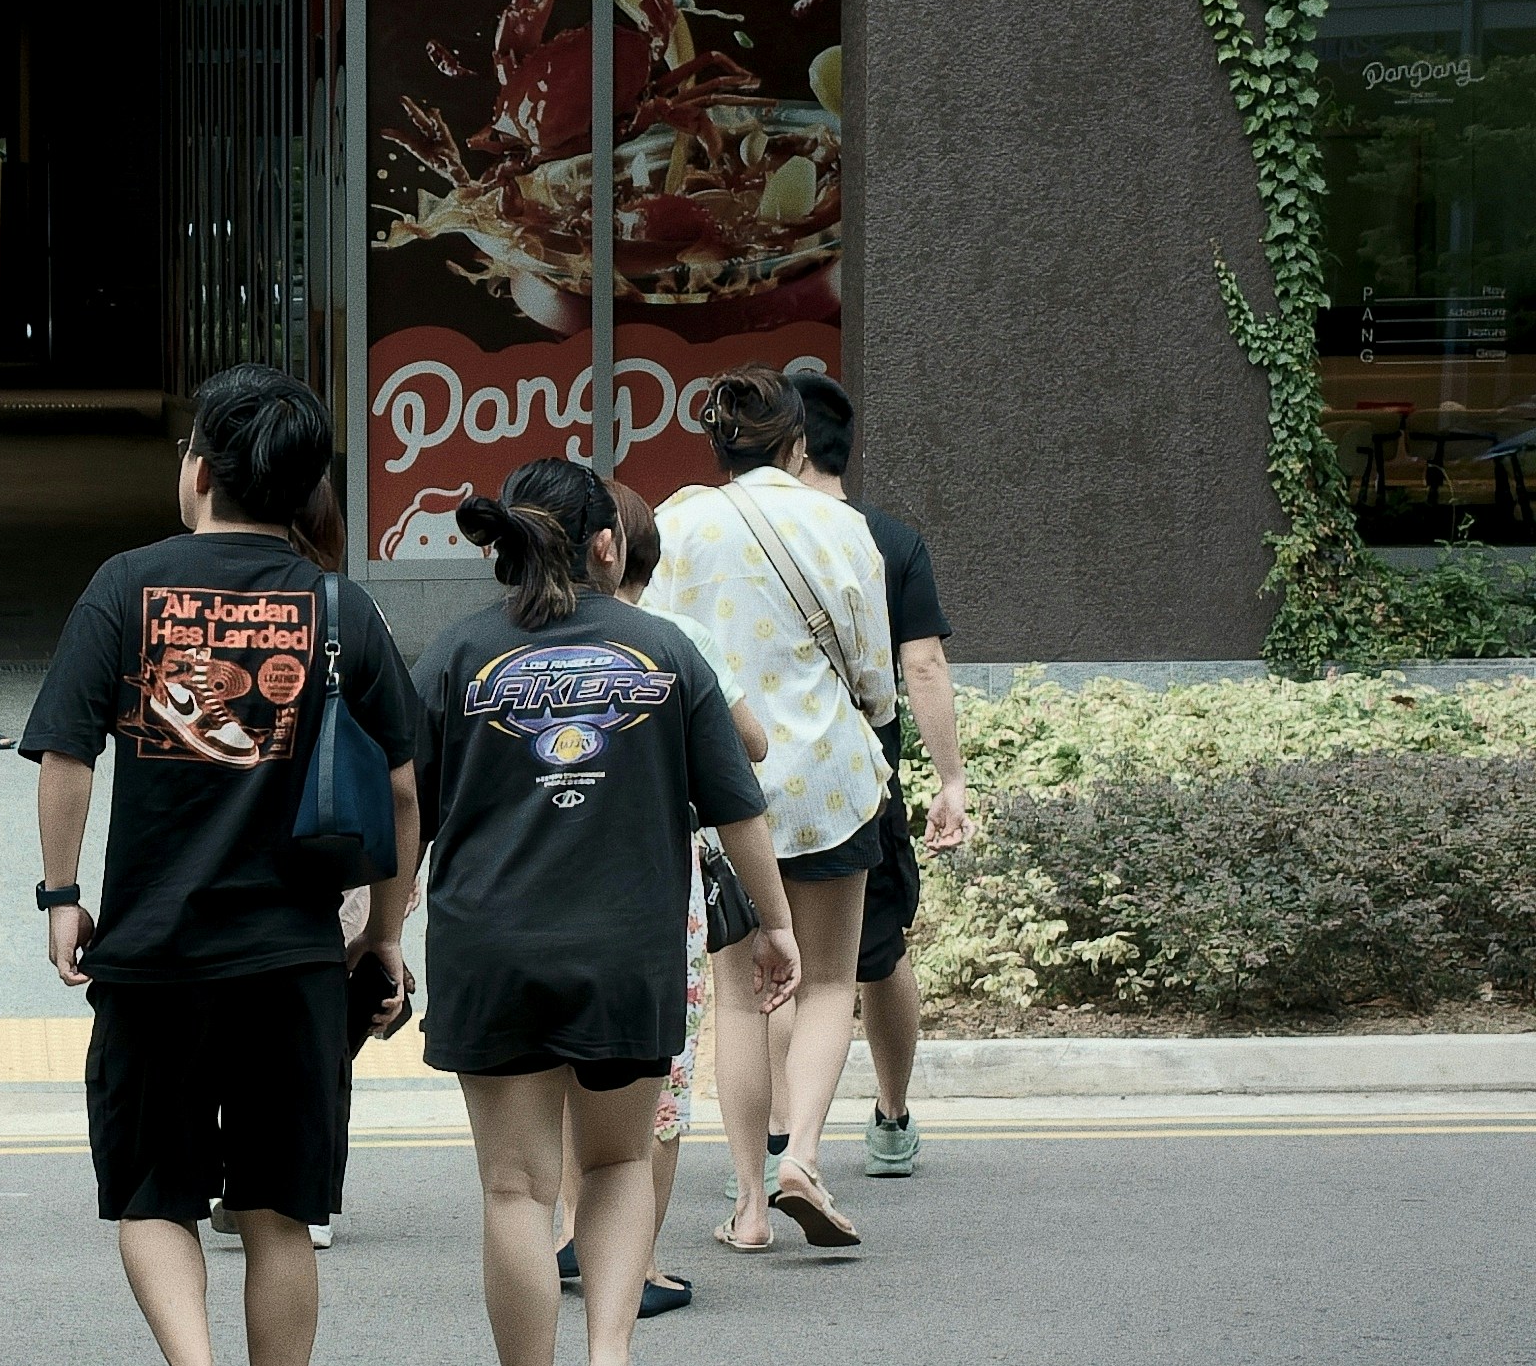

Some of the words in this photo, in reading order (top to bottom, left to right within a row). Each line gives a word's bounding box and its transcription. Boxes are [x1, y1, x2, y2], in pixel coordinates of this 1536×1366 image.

[1362, 59, 1485, 90] PangPang
[1482, 285, 1507, 297] Play
[161, 593, 202, 620] Air
[204, 596, 299, 624] Jordan
[150, 619, 204, 646] Has
[207, 622, 308, 651] Landed
[464, 670, 677, 717] LAKERS
